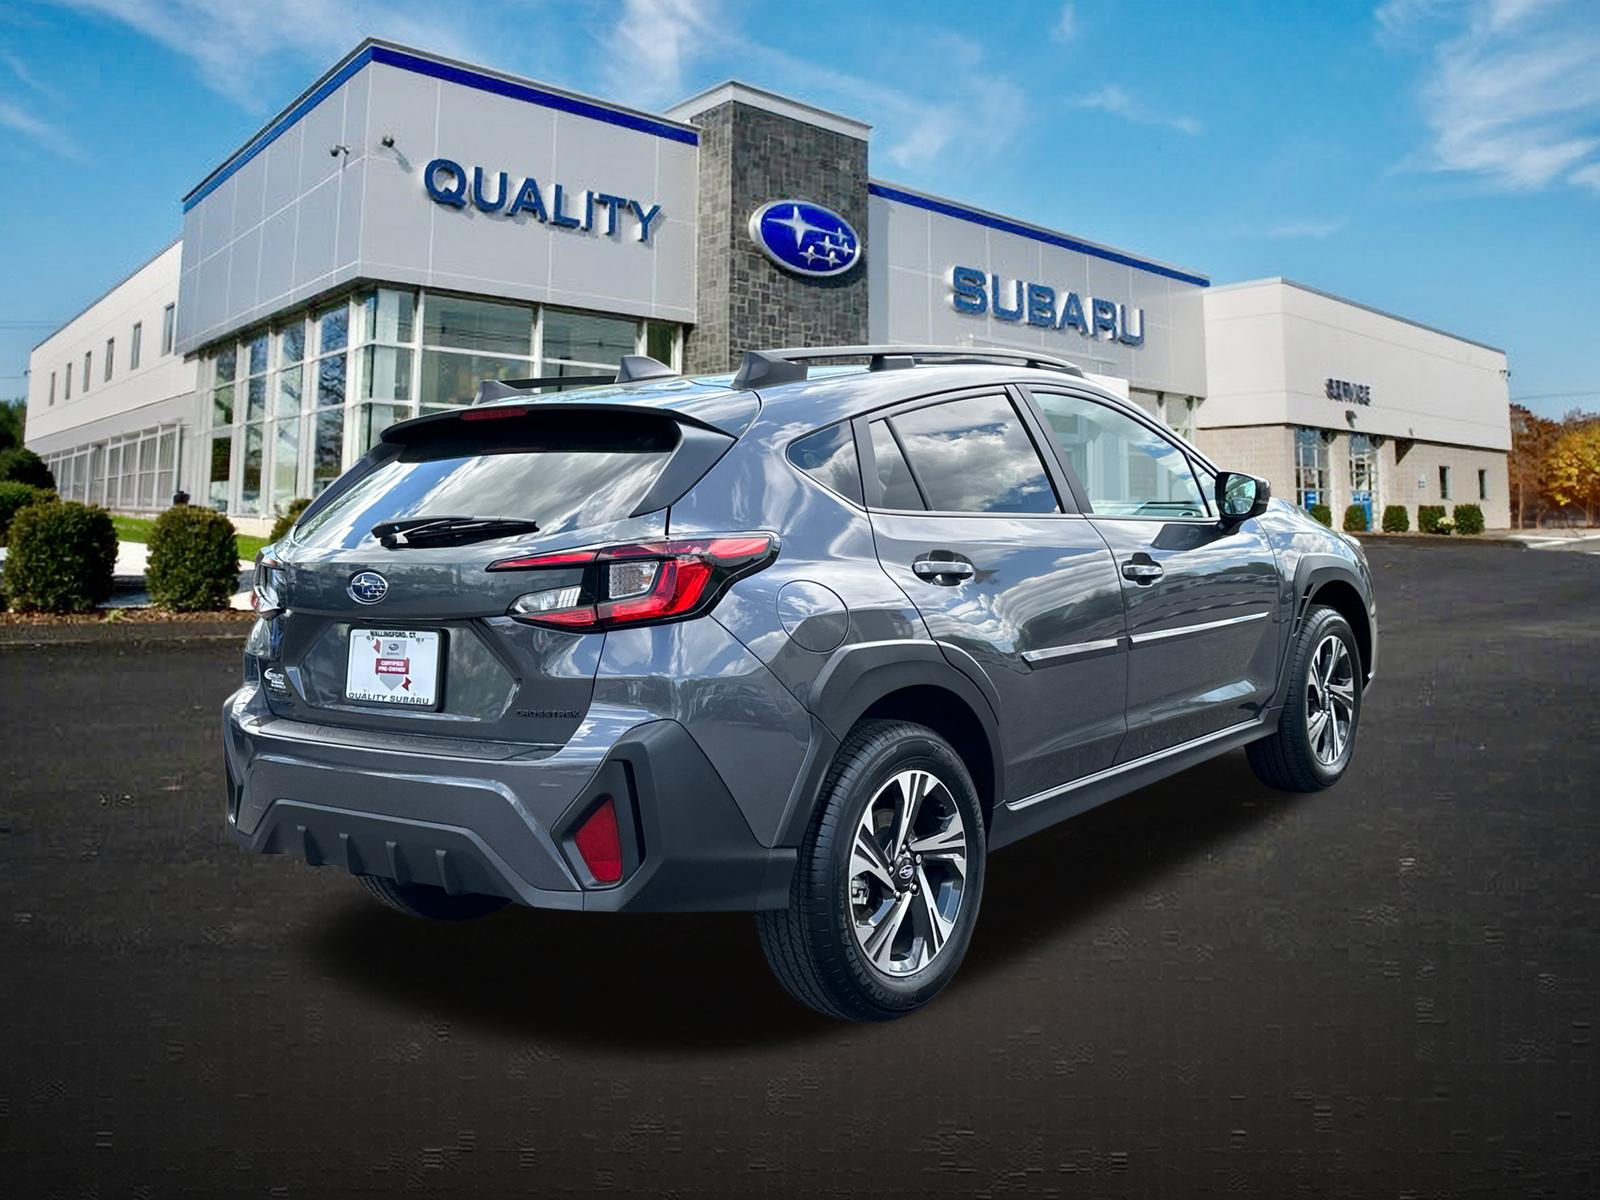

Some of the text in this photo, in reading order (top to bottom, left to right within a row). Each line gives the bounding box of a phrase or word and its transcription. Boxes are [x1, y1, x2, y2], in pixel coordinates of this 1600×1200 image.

[424, 158, 662, 242] QUALITY
[951, 265, 1145, 346] SUBARU
[348, 692, 430, 705] QUALITY SUBARU
